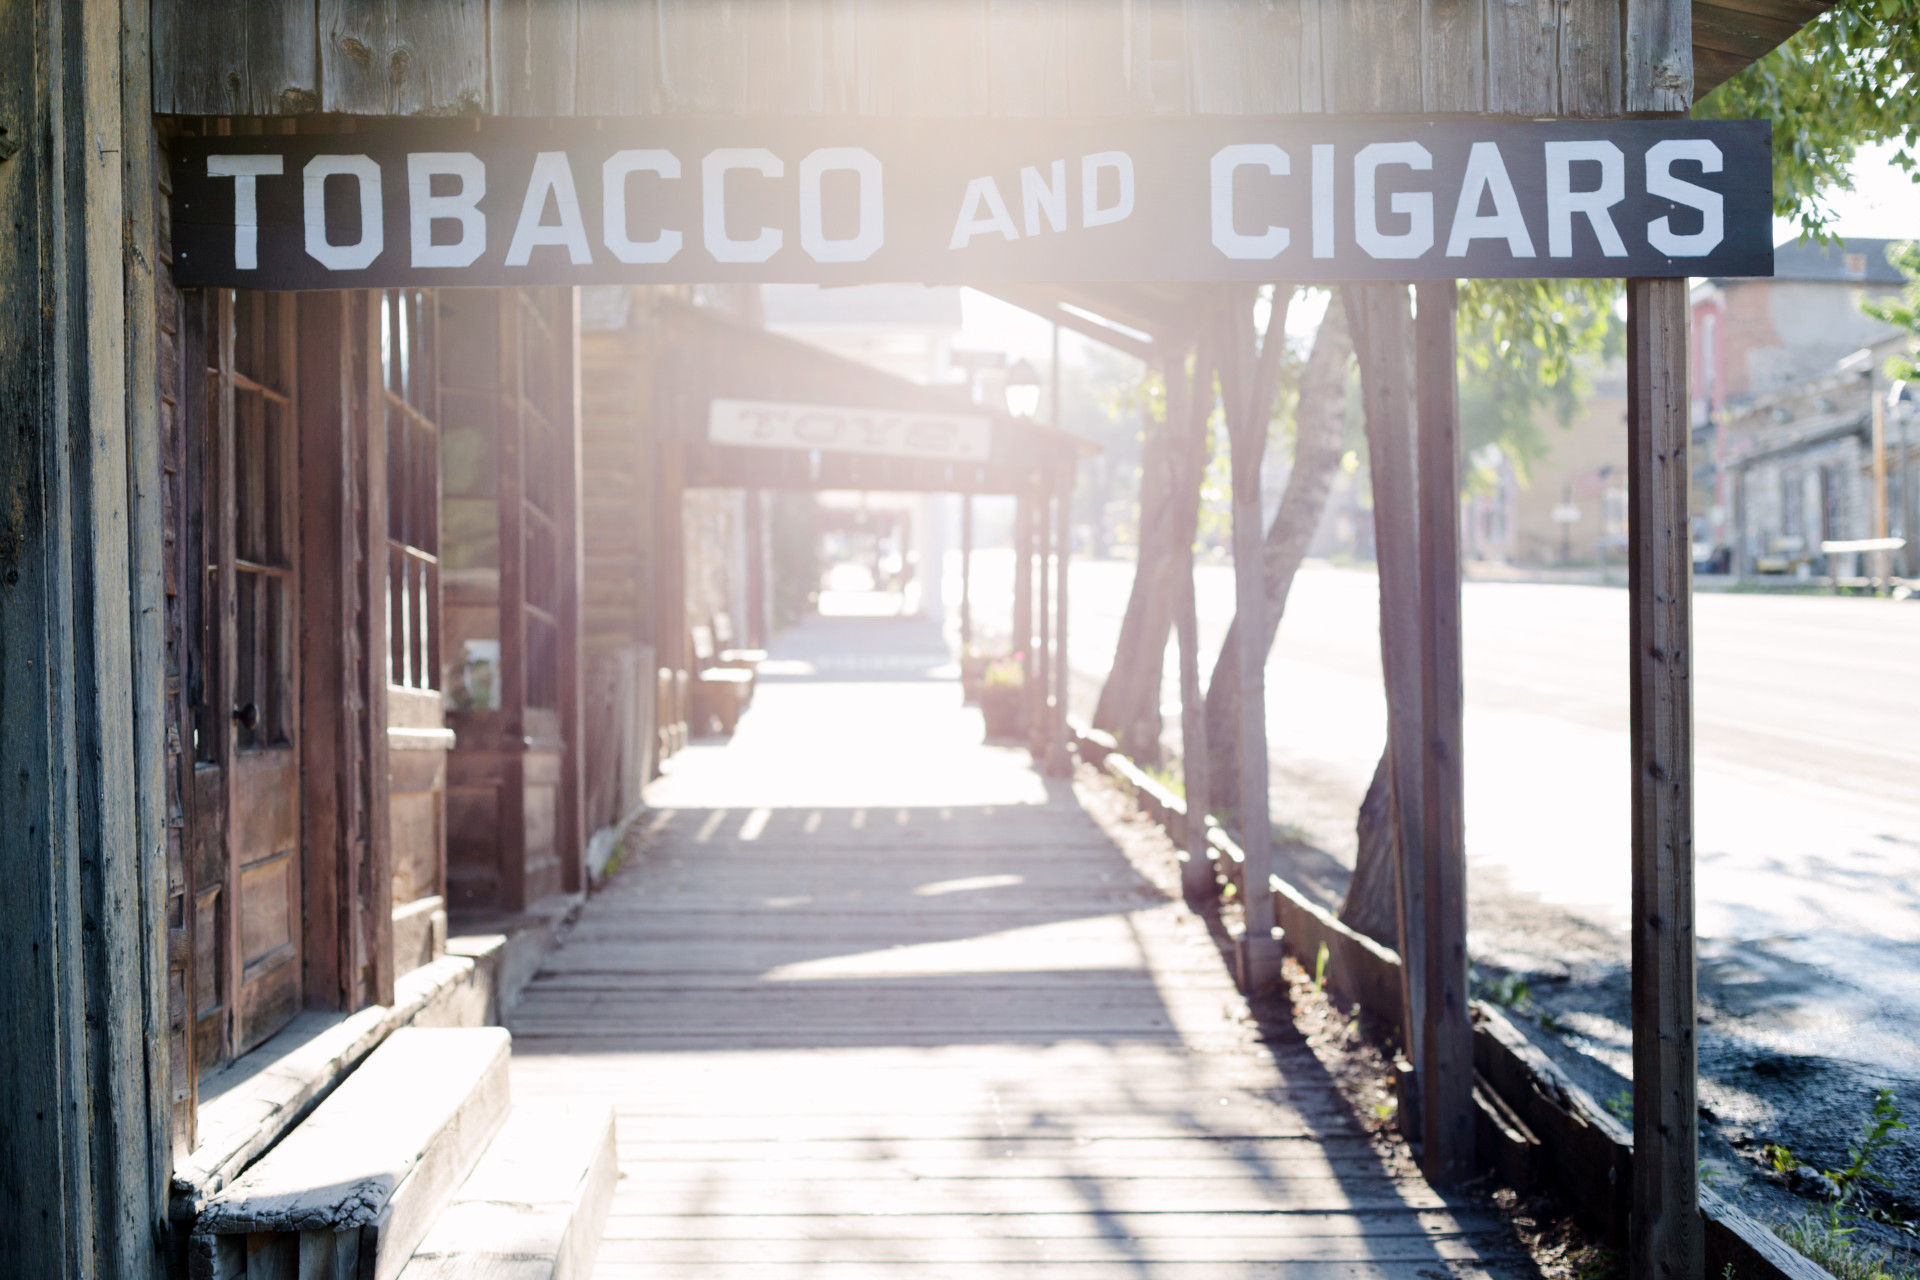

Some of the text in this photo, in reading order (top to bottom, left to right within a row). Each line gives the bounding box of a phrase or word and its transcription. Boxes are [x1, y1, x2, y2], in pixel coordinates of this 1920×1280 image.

[206, 139, 1725, 271] TOBACCO AND CIGARS
